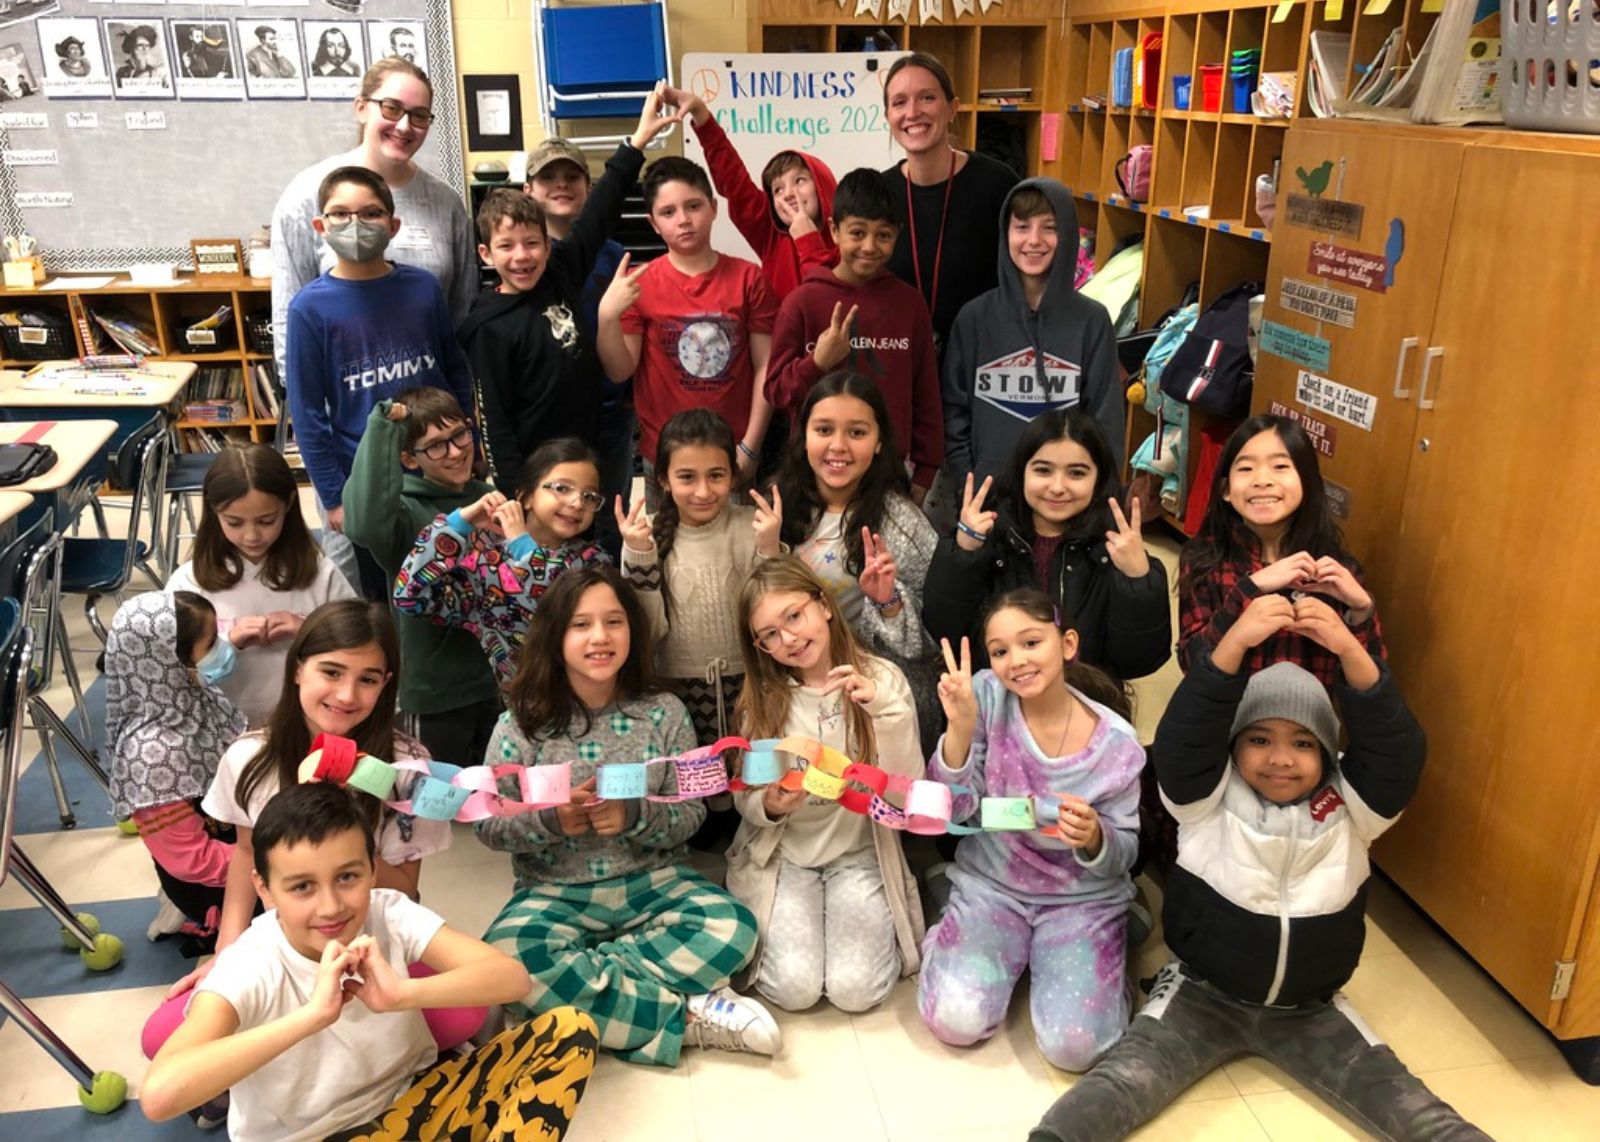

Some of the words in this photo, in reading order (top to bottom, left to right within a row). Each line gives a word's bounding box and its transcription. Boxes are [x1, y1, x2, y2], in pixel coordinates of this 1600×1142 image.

[730, 70, 856, 99] KINDNESS
[716, 103, 831, 149] Challenge
[876, 338, 909, 350] JEANS
[343, 354, 436, 391] TOMMY
[1324, 382, 1334, 396] on
[1271, 401, 1288, 417] PICK
[1302, 414, 1326, 437] TRASH
